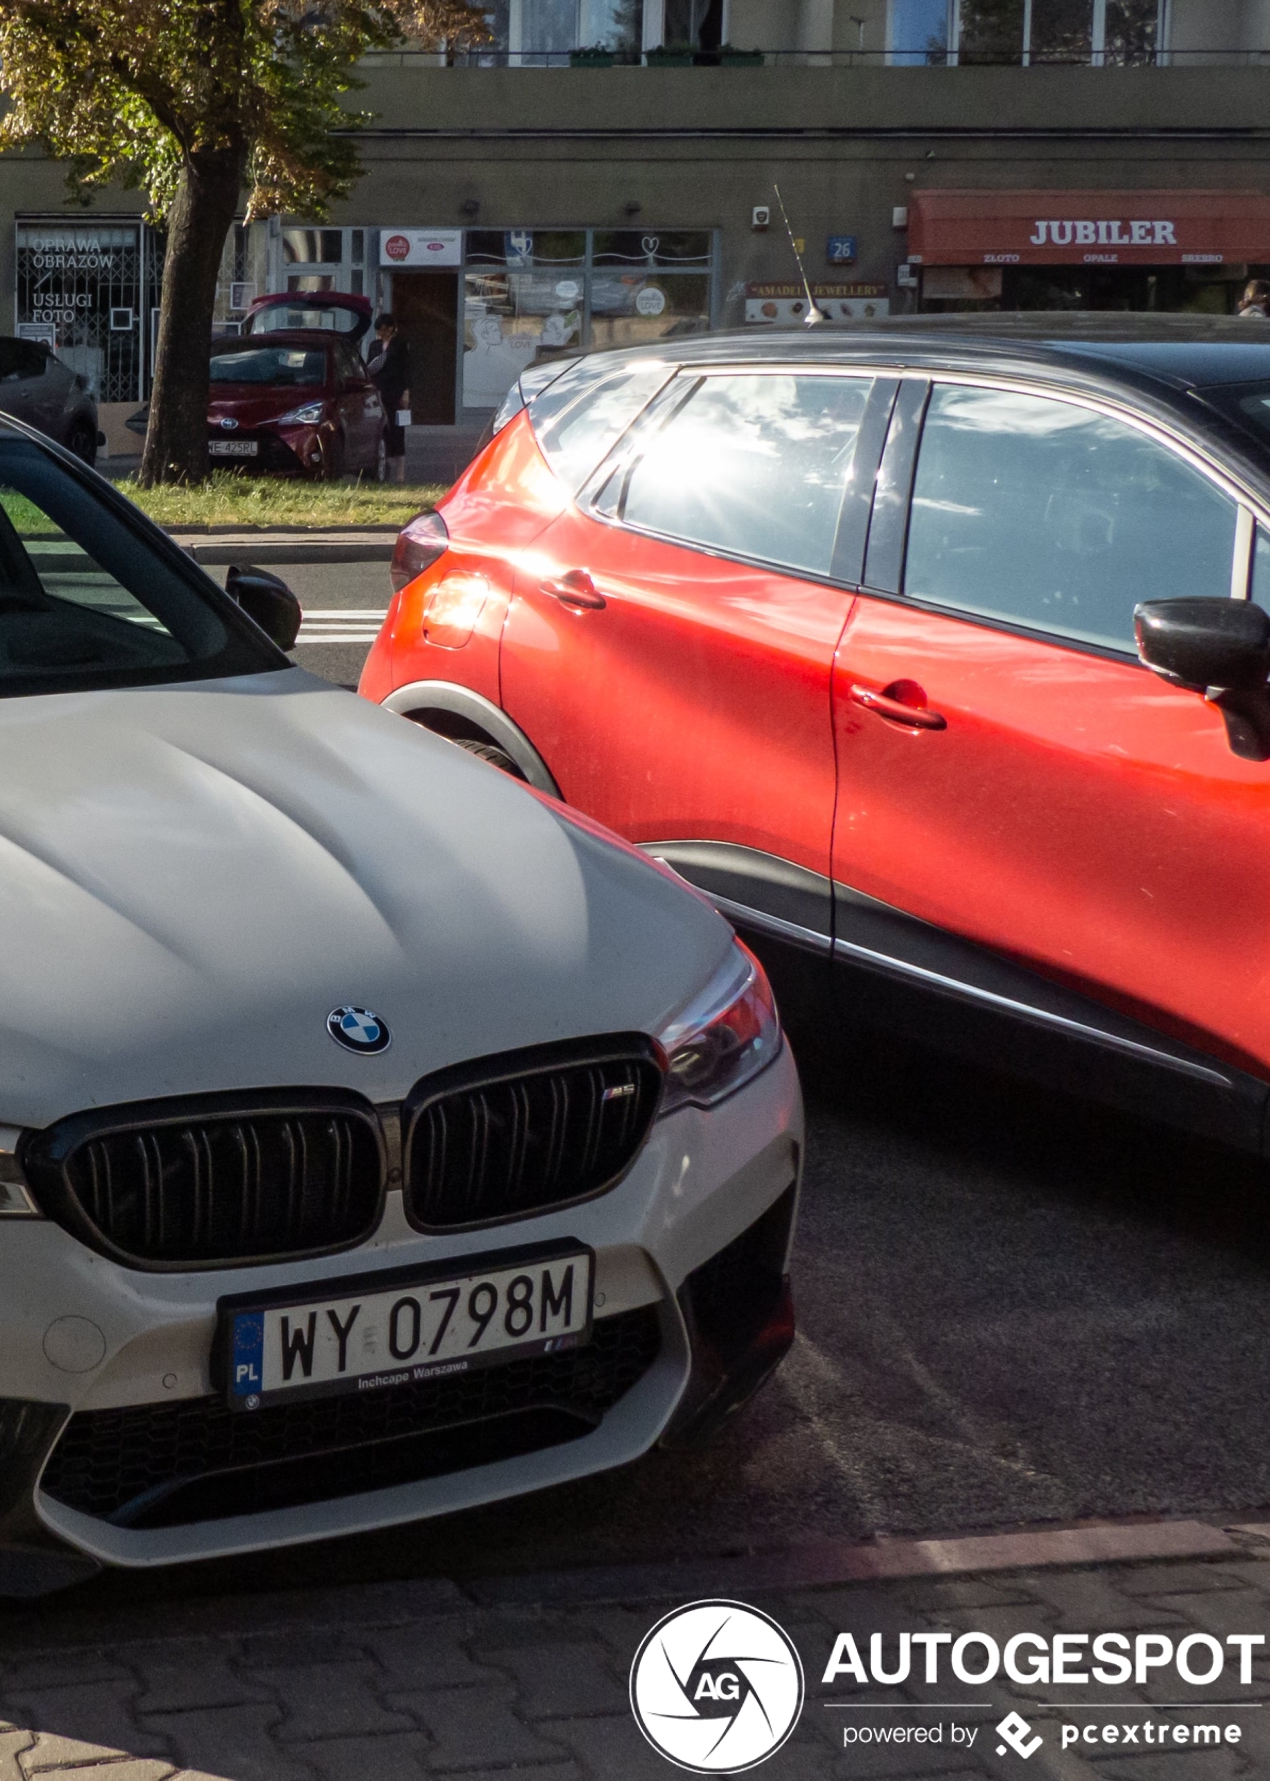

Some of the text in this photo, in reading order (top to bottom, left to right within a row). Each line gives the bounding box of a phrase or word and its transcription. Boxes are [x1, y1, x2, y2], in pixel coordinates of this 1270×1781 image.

[1030, 220, 1177, 245] JUBILER
[33, 239, 101, 252] OPRAWA
[834, 242, 851, 257] 26
[33, 253, 113, 268] OBRAZÓW
[1083, 254, 1118, 263] OPALE
[1181, 254, 1223, 263] SREBRO
[33, 294, 92, 307] USŁUGI
[33, 310, 75, 323] FOTO
[330, 1006, 377, 1023] BMW
[280, 1264, 574, 1382] WY 0798M
[236, 1363, 259, 1383] PL
[358, 1359, 469, 1390] Inchcape Warszawa
